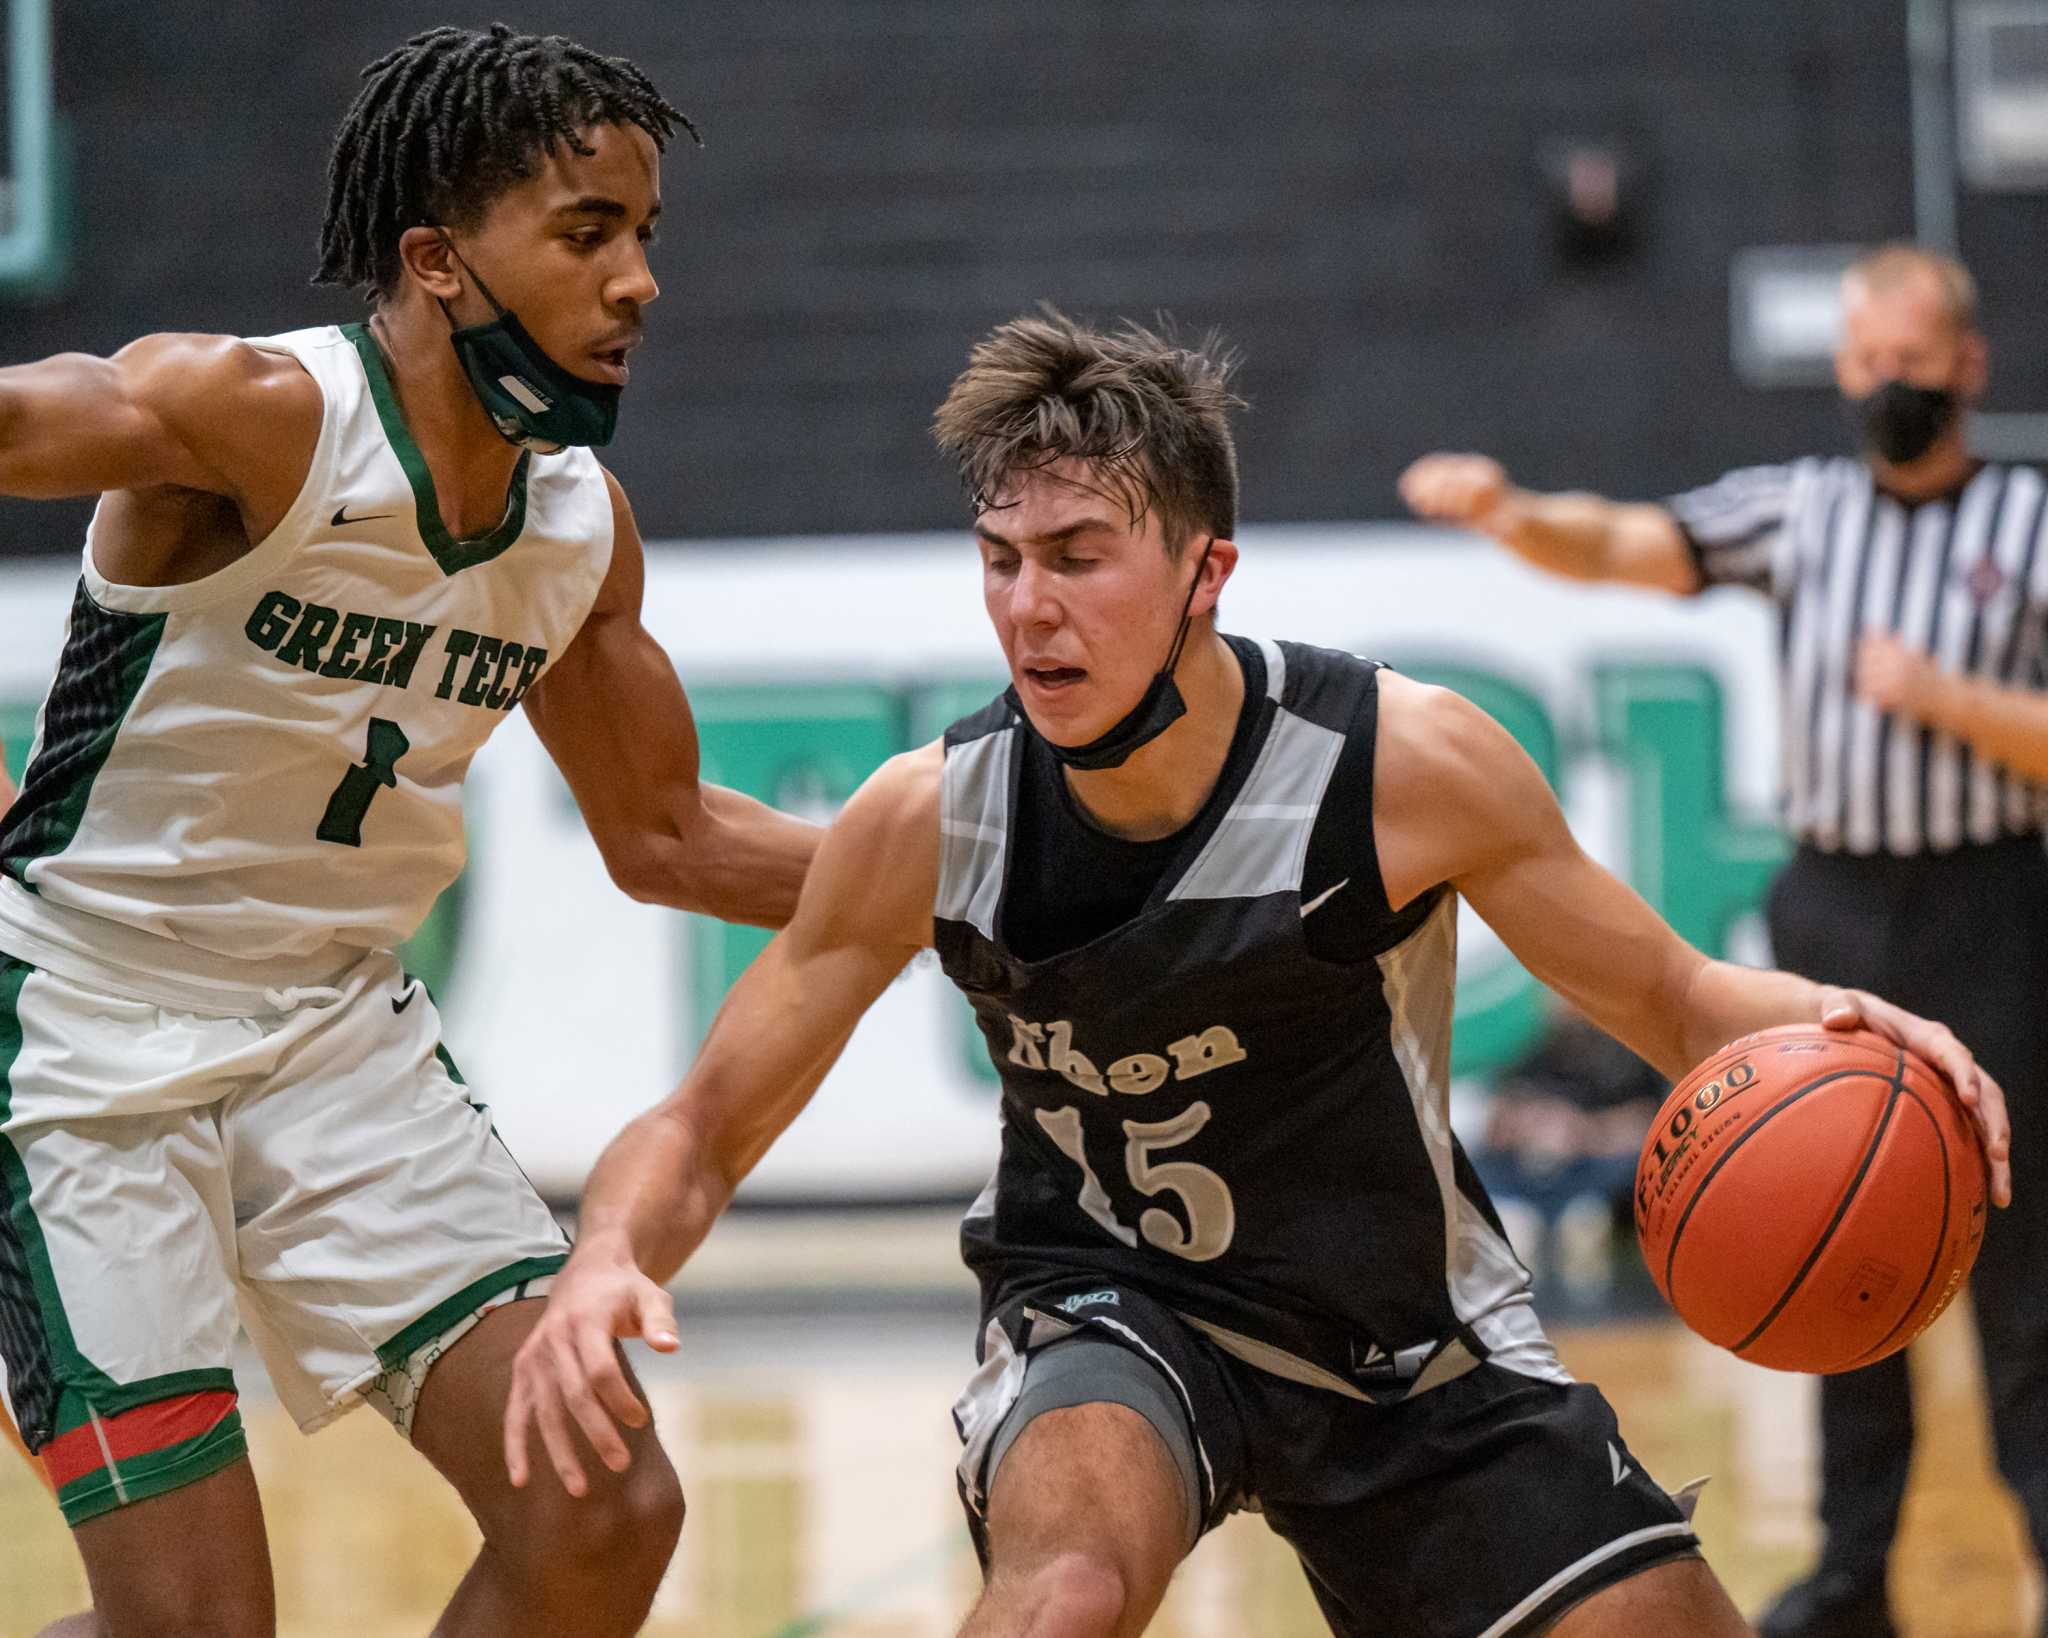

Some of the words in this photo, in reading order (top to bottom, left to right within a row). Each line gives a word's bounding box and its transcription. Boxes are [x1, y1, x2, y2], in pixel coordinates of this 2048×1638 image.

[244, 590, 437, 690] GREEN
[435, 628, 548, 711] TECH
[315, 716, 410, 848] 1
[1034, 1100, 1235, 1262] 15
